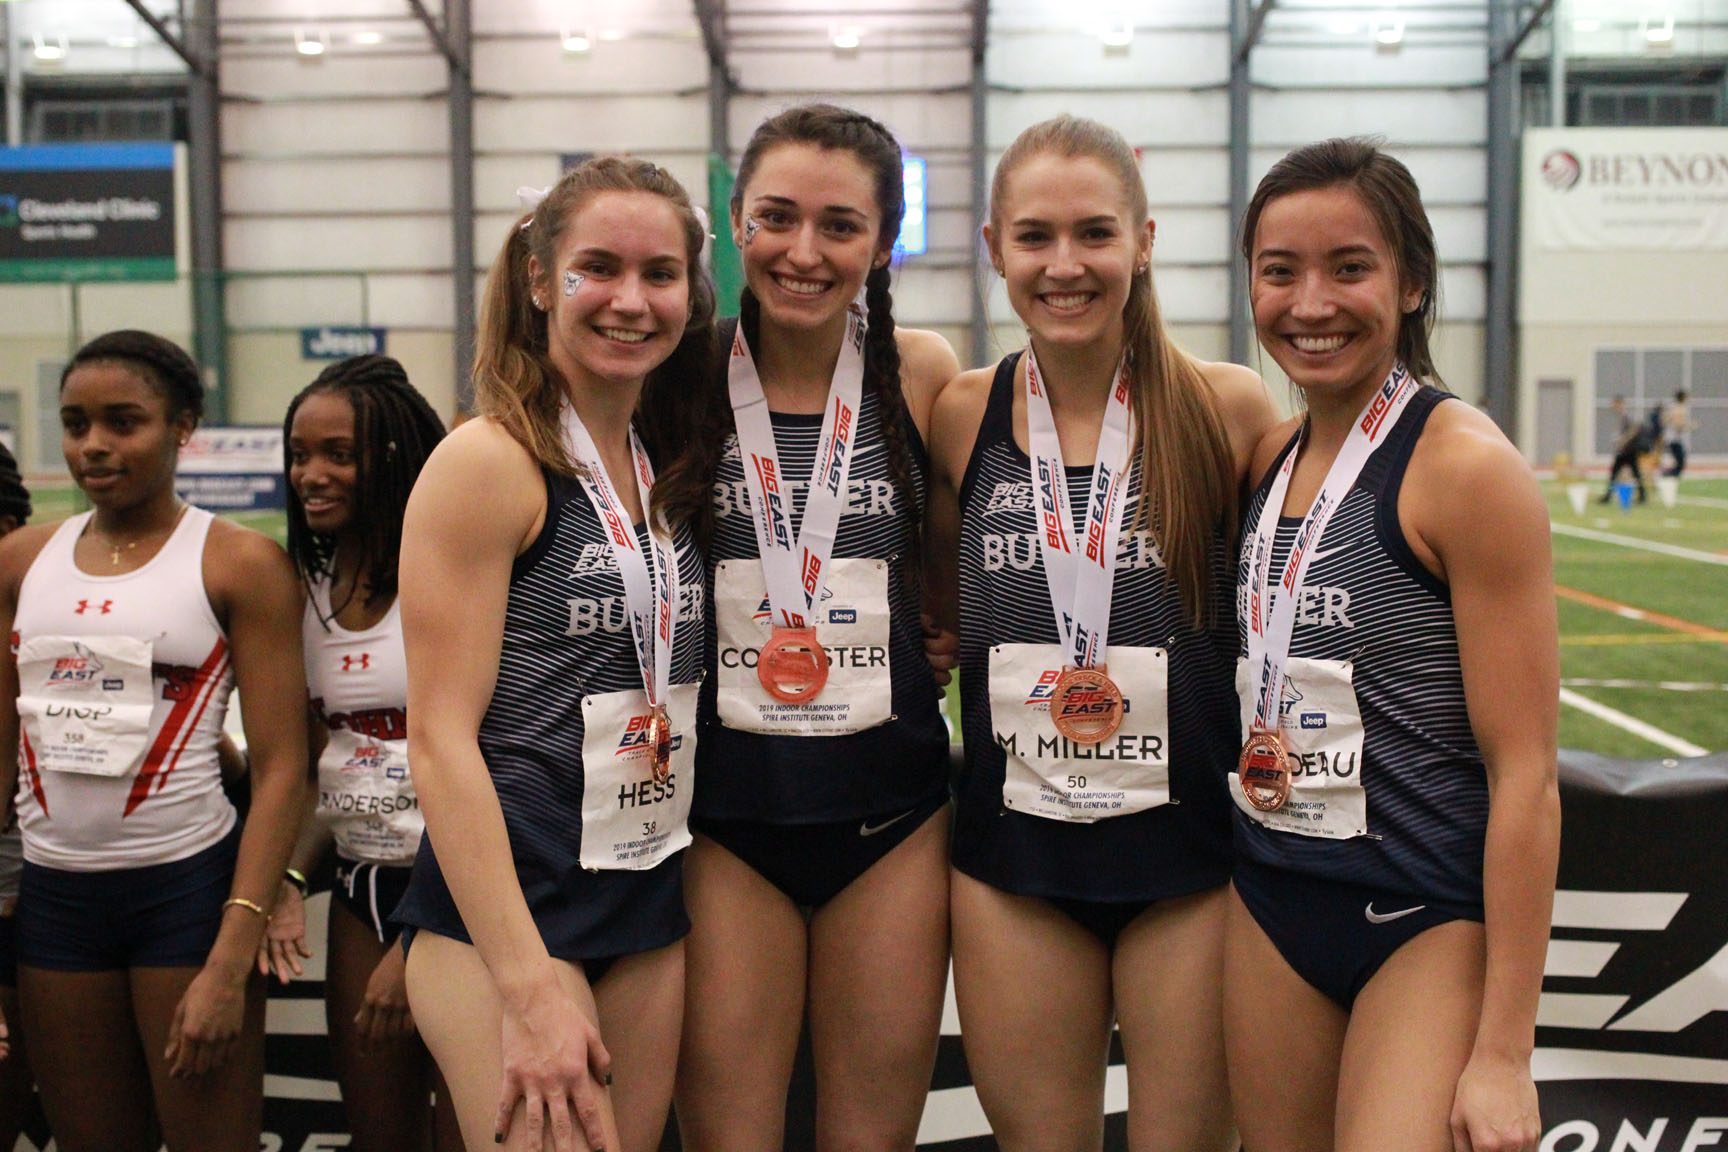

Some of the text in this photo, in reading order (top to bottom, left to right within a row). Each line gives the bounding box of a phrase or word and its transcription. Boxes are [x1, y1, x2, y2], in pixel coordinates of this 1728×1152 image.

[831, 611, 855, 622] Jeep
[1061, 702, 1118, 715] EAST
[1303, 715, 1325, 727] Jeep
[997, 732, 1162, 760] M. MILLER
[1067, 775, 1087, 788] 50
[618, 774, 676, 810] HESS
[642, 821, 657, 836] 38
